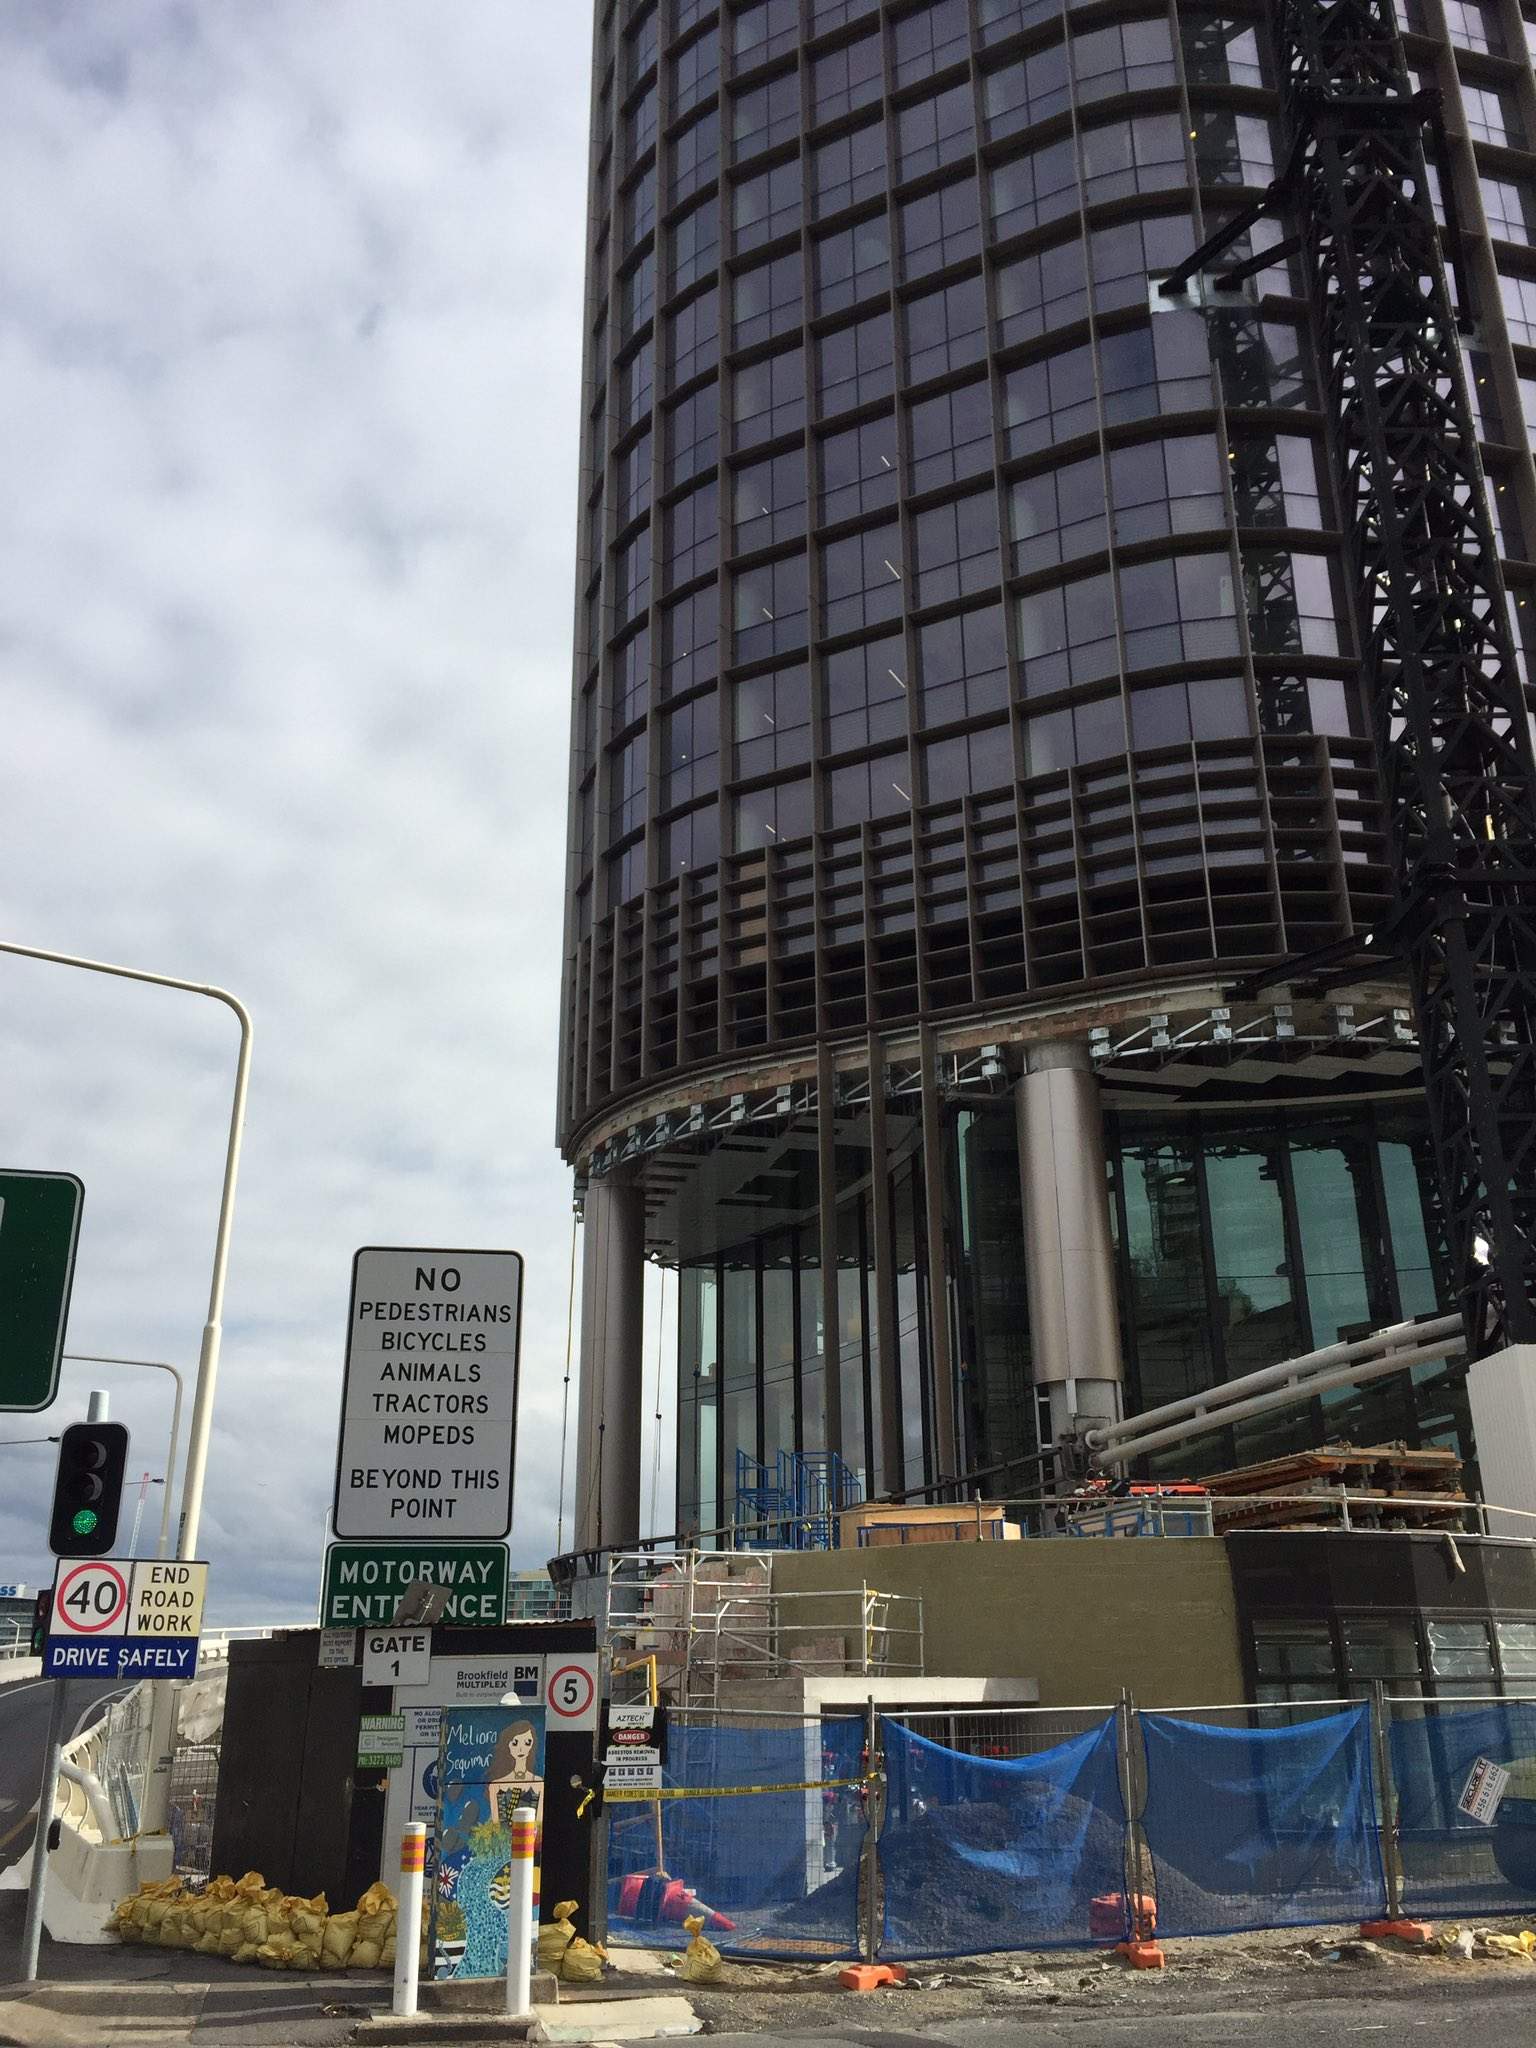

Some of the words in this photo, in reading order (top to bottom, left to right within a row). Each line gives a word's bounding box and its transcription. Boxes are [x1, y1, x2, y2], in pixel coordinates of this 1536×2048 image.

[415, 1267, 461, 1292] NO
[359, 1301, 512, 1323] PEDESTRIANS
[381, 1331, 487, 1351] BICYCLES
[380, 1362, 481, 1382] ANIMALS
[372, 1393, 489, 1414] TRACTORS
[383, 1424, 475, 1445] MOPEDS
[350, 1468, 442, 1489] BEYOND
[451, 1469, 500, 1490] THIS
[390, 1498, 457, 1518] POINT
[151, 1566, 190, 1584] END
[339, 1560, 494, 1584] MOTORWAY
[65, 1580, 118, 1615] 40
[140, 1590, 194, 1608] ROAD
[331, 1594, 497, 1619] ENTNCE
[137, 1614, 193, 1632] WORK
[370, 1636, 425, 1653] GATE
[52, 1647, 110, 1667] DRIVE
[117, 1648, 190, 1667] SAFELY
[391, 1660, 400, 1677] 1
[457, 1671, 508, 1680] Brookfield
[514, 1666, 538, 1679] BM
[456, 1681, 507, 1689] MULTIPLEX
[563, 1679, 578, 1704] 5
[361, 1717, 404, 1730] WARNING
[447, 1724, 497, 1746] Meliora
[446, 1752, 493, 1778] Sequimur
[1478, 1760, 1487, 1770] IT
